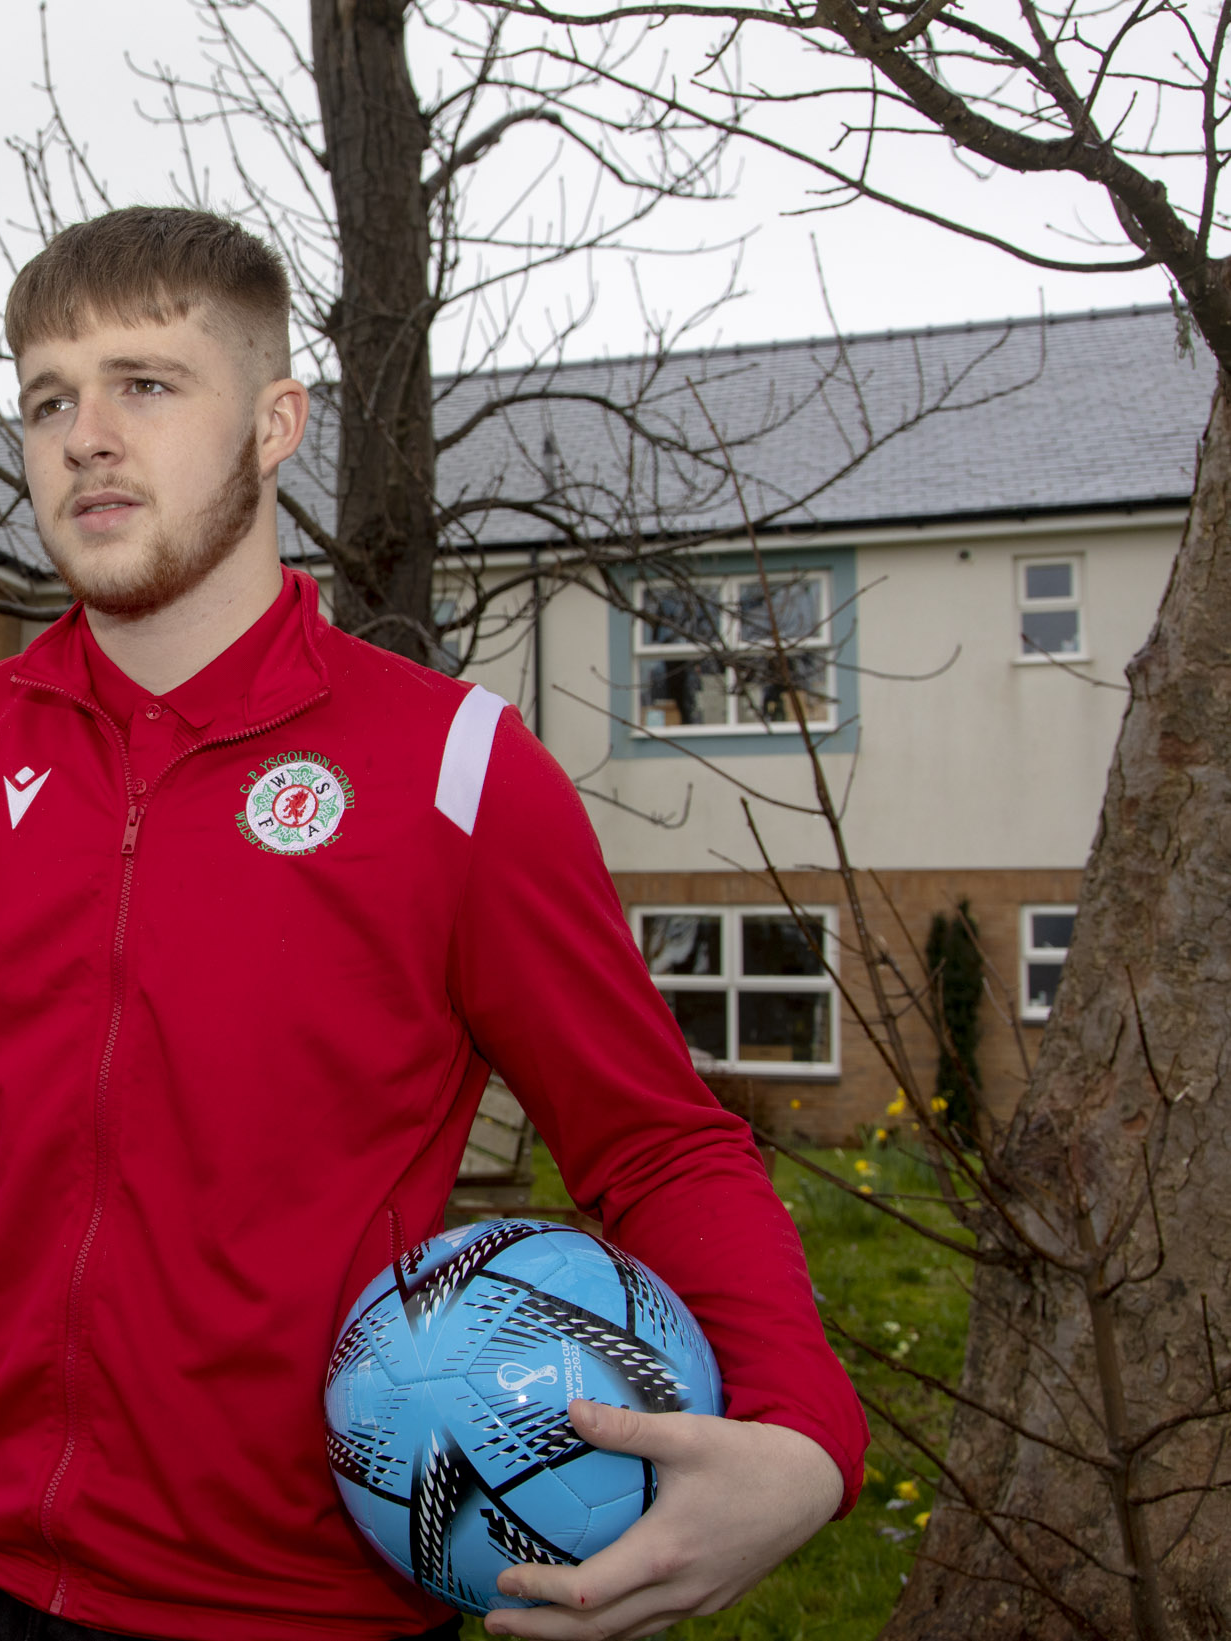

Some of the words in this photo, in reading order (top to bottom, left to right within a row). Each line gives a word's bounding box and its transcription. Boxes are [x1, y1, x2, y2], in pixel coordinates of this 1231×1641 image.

[259, 750, 331, 772] YSGOLION
[330, 765, 355, 809] CYMRU
[270, 772, 288, 789] W
[315, 782, 331, 795] S
[235, 810, 260, 845] WELSH
[258, 816, 274, 828] F
[308, 825, 320, 838] A
[560, 1339, 570, 1357] CUP
[563, 1358, 574, 1391] WORLD
